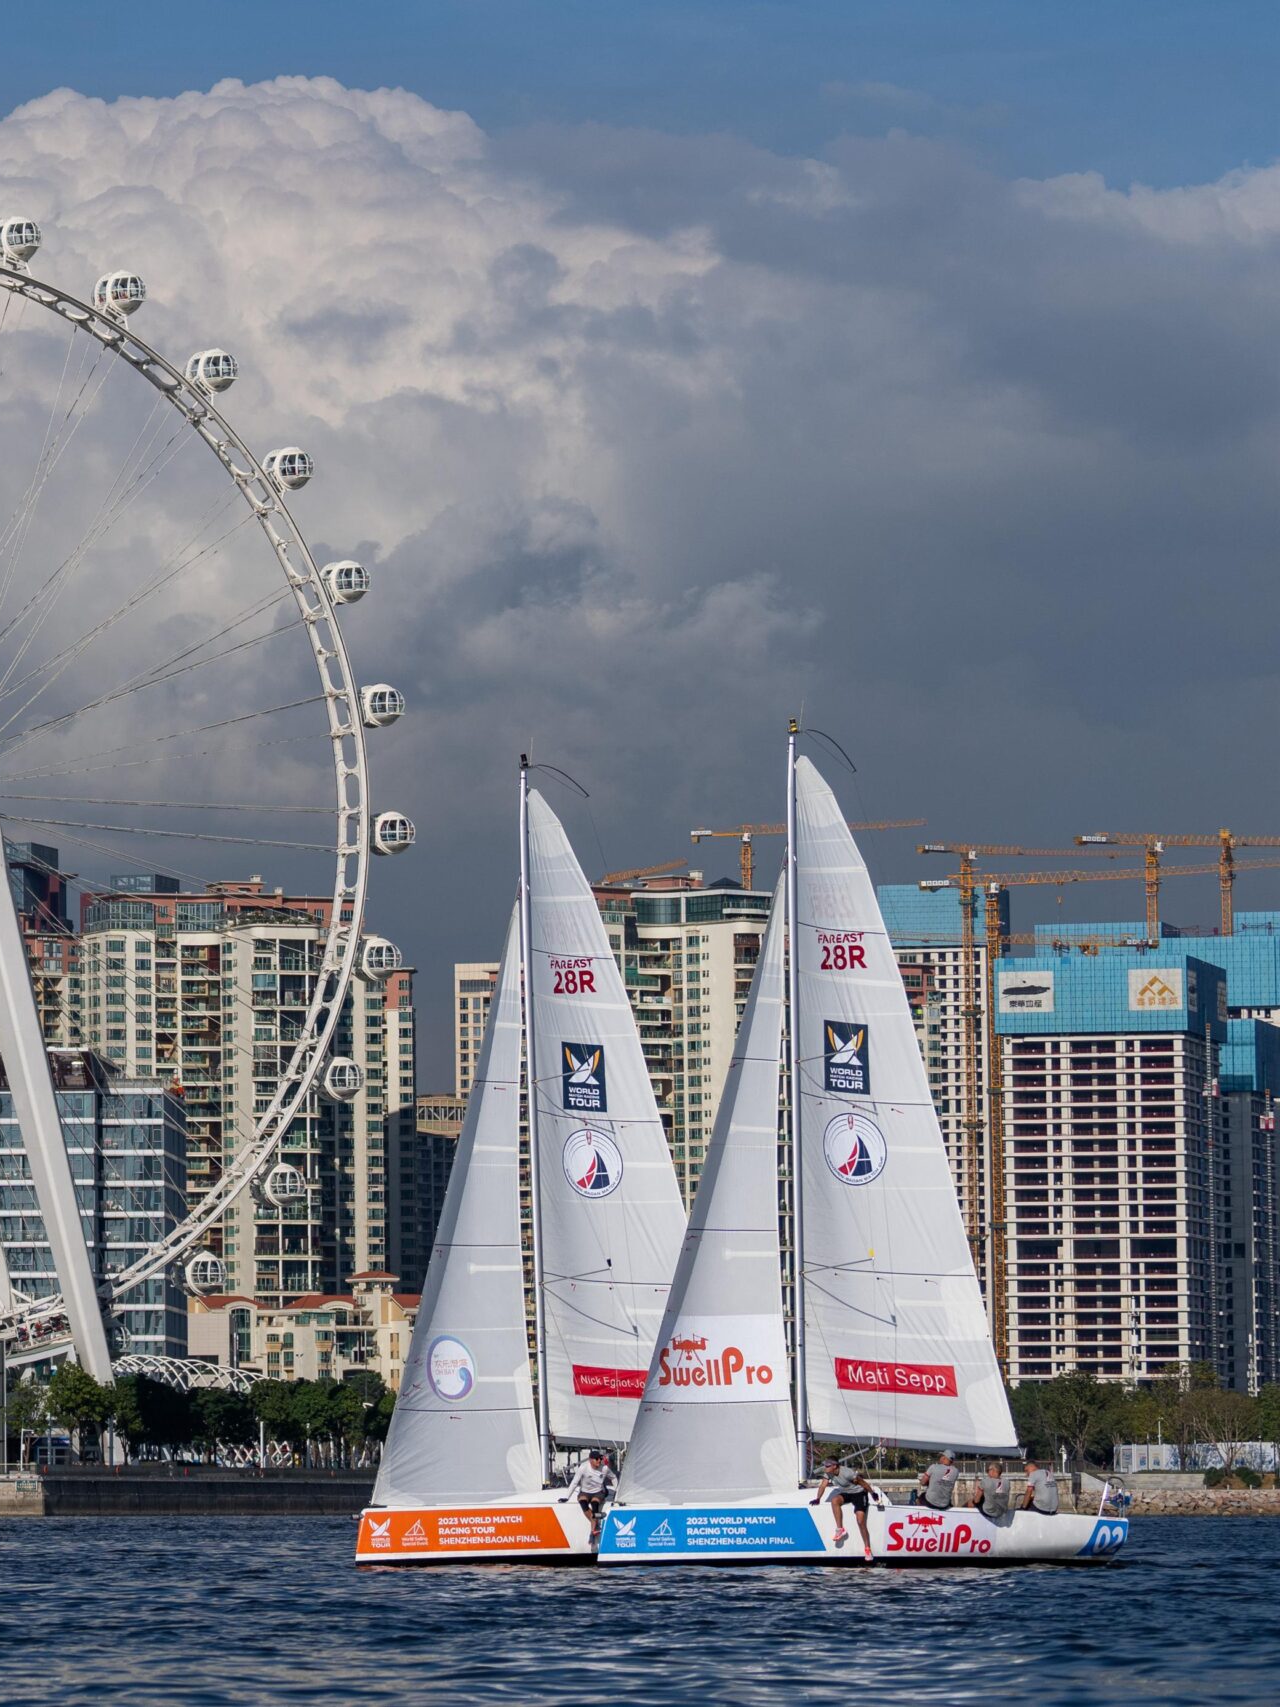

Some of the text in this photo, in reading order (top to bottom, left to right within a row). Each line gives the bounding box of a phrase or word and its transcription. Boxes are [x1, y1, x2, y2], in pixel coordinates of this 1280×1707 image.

[817, 932, 864, 944] FAREAST
[820, 945, 868, 970] 28R
[550, 958, 593, 969] FAREAST
[553, 970, 597, 994] 28R
[830, 1067, 863, 1077] WORLD
[830, 1078, 863, 1090] TOUR
[568, 1086, 600, 1095] WORLD
[568, 1097, 600, 1108] TOUR
[659, 1346, 773, 1387] SwellPro
[580, 1374, 602, 1386] Nick
[847, 1365, 947, 1392] Mati Sepp
[438, 1515, 522, 1525] 2023 WORLD MATCH
[686, 1516, 776, 1525] 2023 WORLD MATCH
[438, 1526, 495, 1535] RACING TOUR
[687, 1527, 747, 1535] RACING TOUR
[516, 1535, 541, 1543] FINAL
[769, 1536, 795, 1544] FINAL
[886, 1522, 991, 1553] SwellPro
[1092, 1525, 1124, 1554] 02
